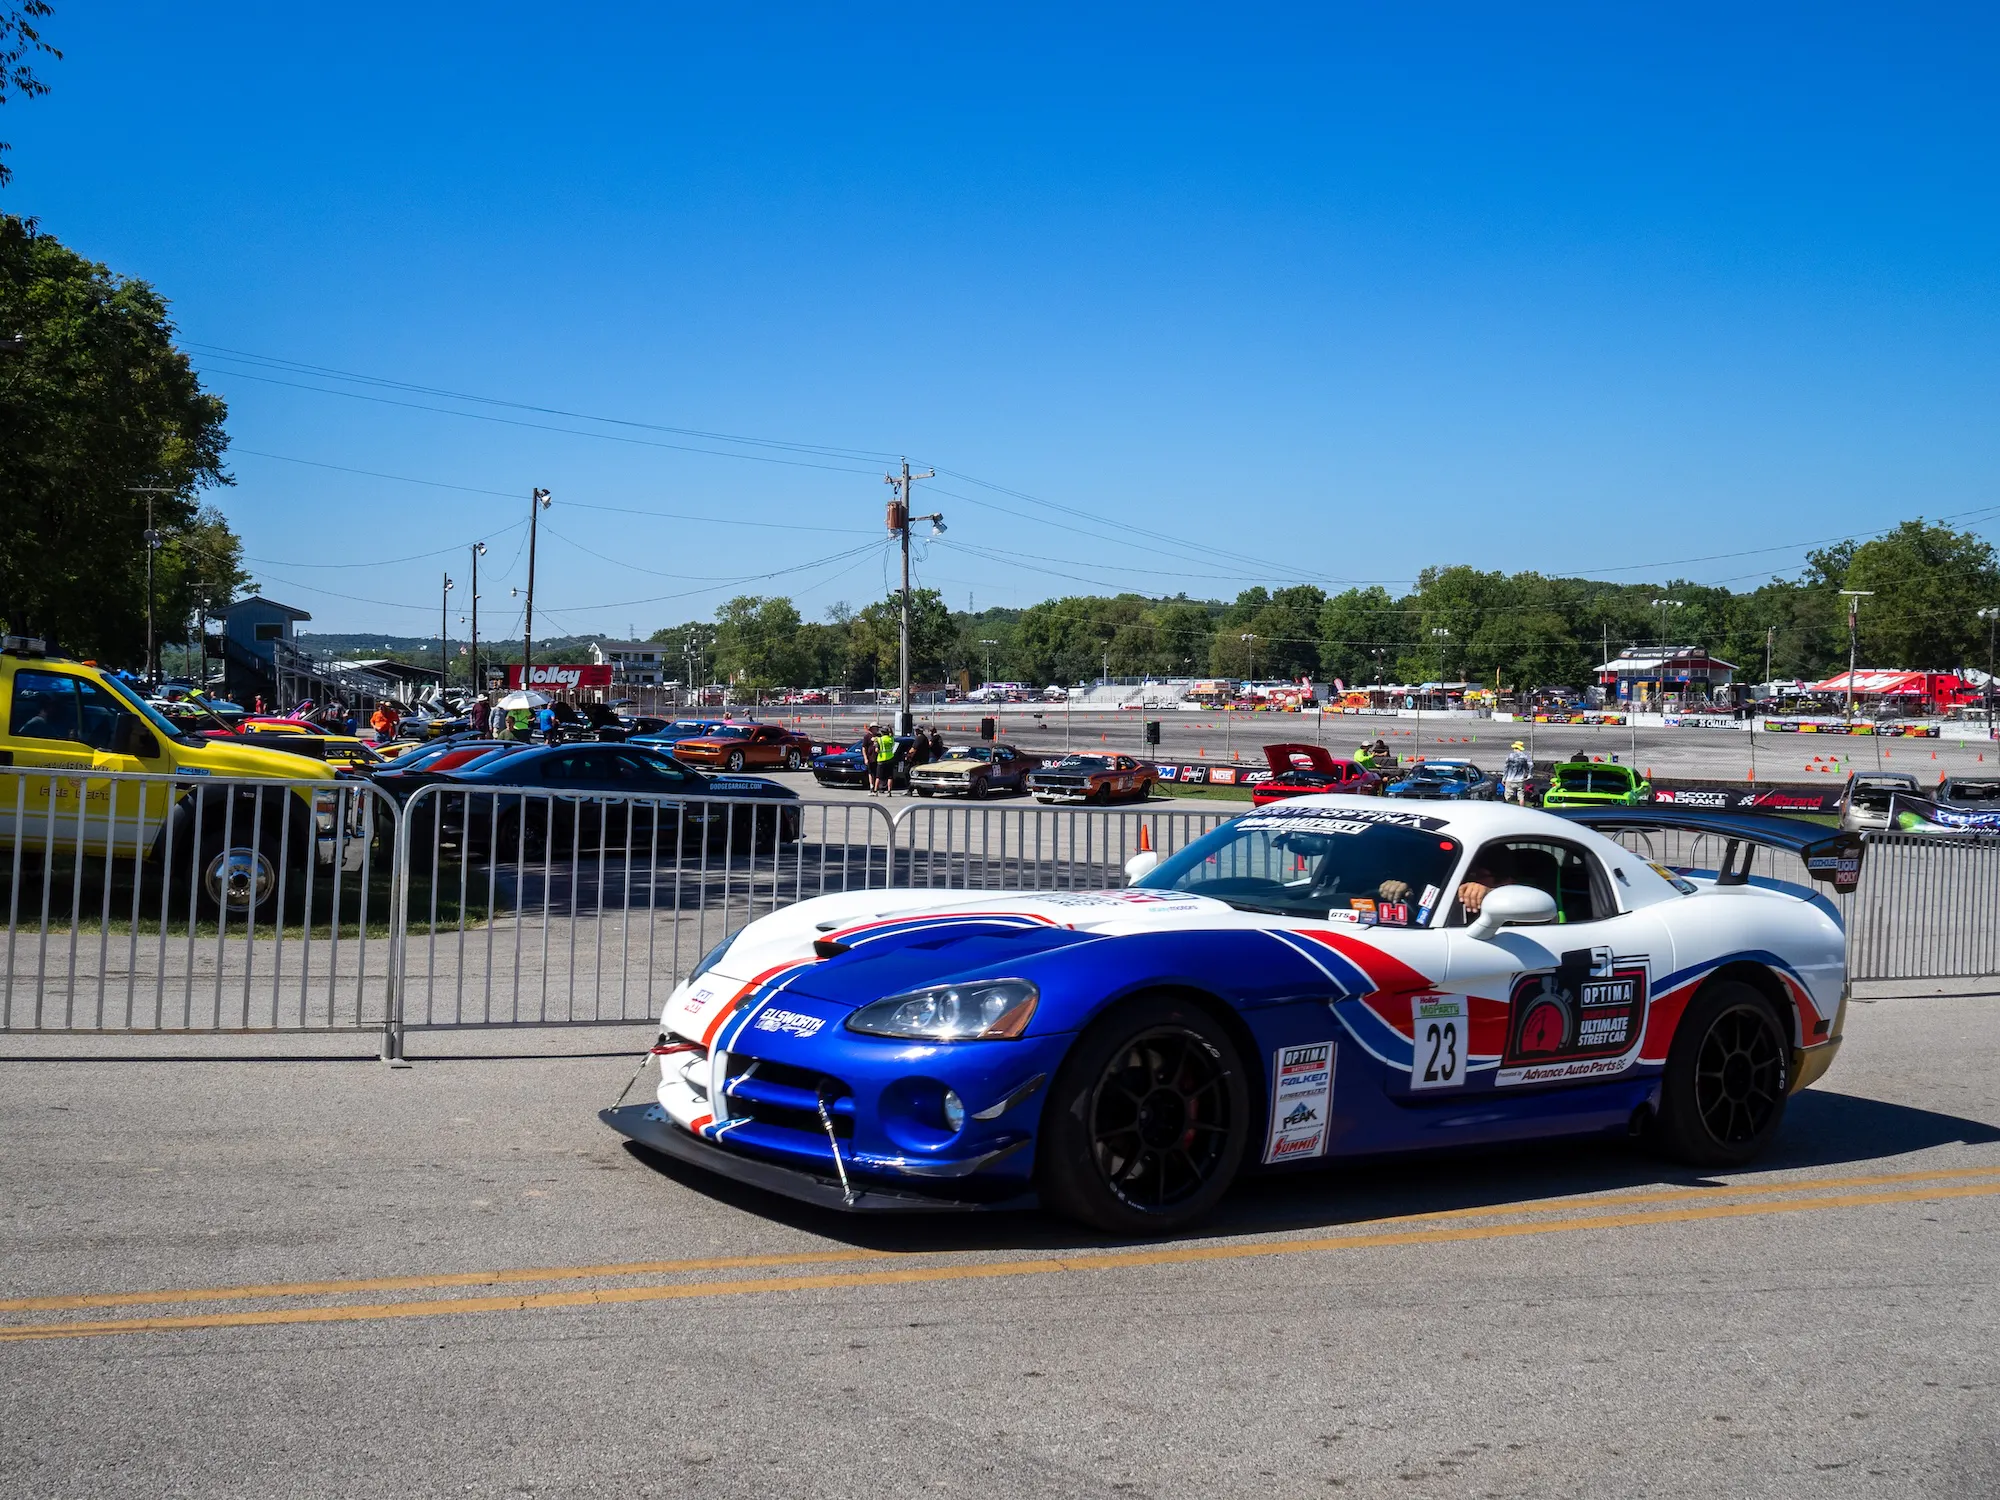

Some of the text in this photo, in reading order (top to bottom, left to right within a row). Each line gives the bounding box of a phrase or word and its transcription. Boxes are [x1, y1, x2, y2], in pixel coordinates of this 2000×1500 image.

[518, 666, 582, 688] Holley
[1674, 791, 1725, 799] SCOTT
[1674, 797, 1725, 805] DRAKE
[1837, 872, 1857, 882] MOLY
[1583, 984, 1631, 1004] OPTIMA
[760, 1008, 826, 1031] ELLSWORTH
[1580, 1017, 1629, 1034] ULTIMATE
[1578, 1031, 1626, 1046] STREET CAR
[1285, 1047, 1326, 1065] OPTIMA
[1423, 1022, 1457, 1082] 23
[1522, 1061, 1616, 1080] Advance Auto Parts
[1280, 1073, 1328, 1087] FALKEN
[1283, 1108, 1317, 1130] PEAK
